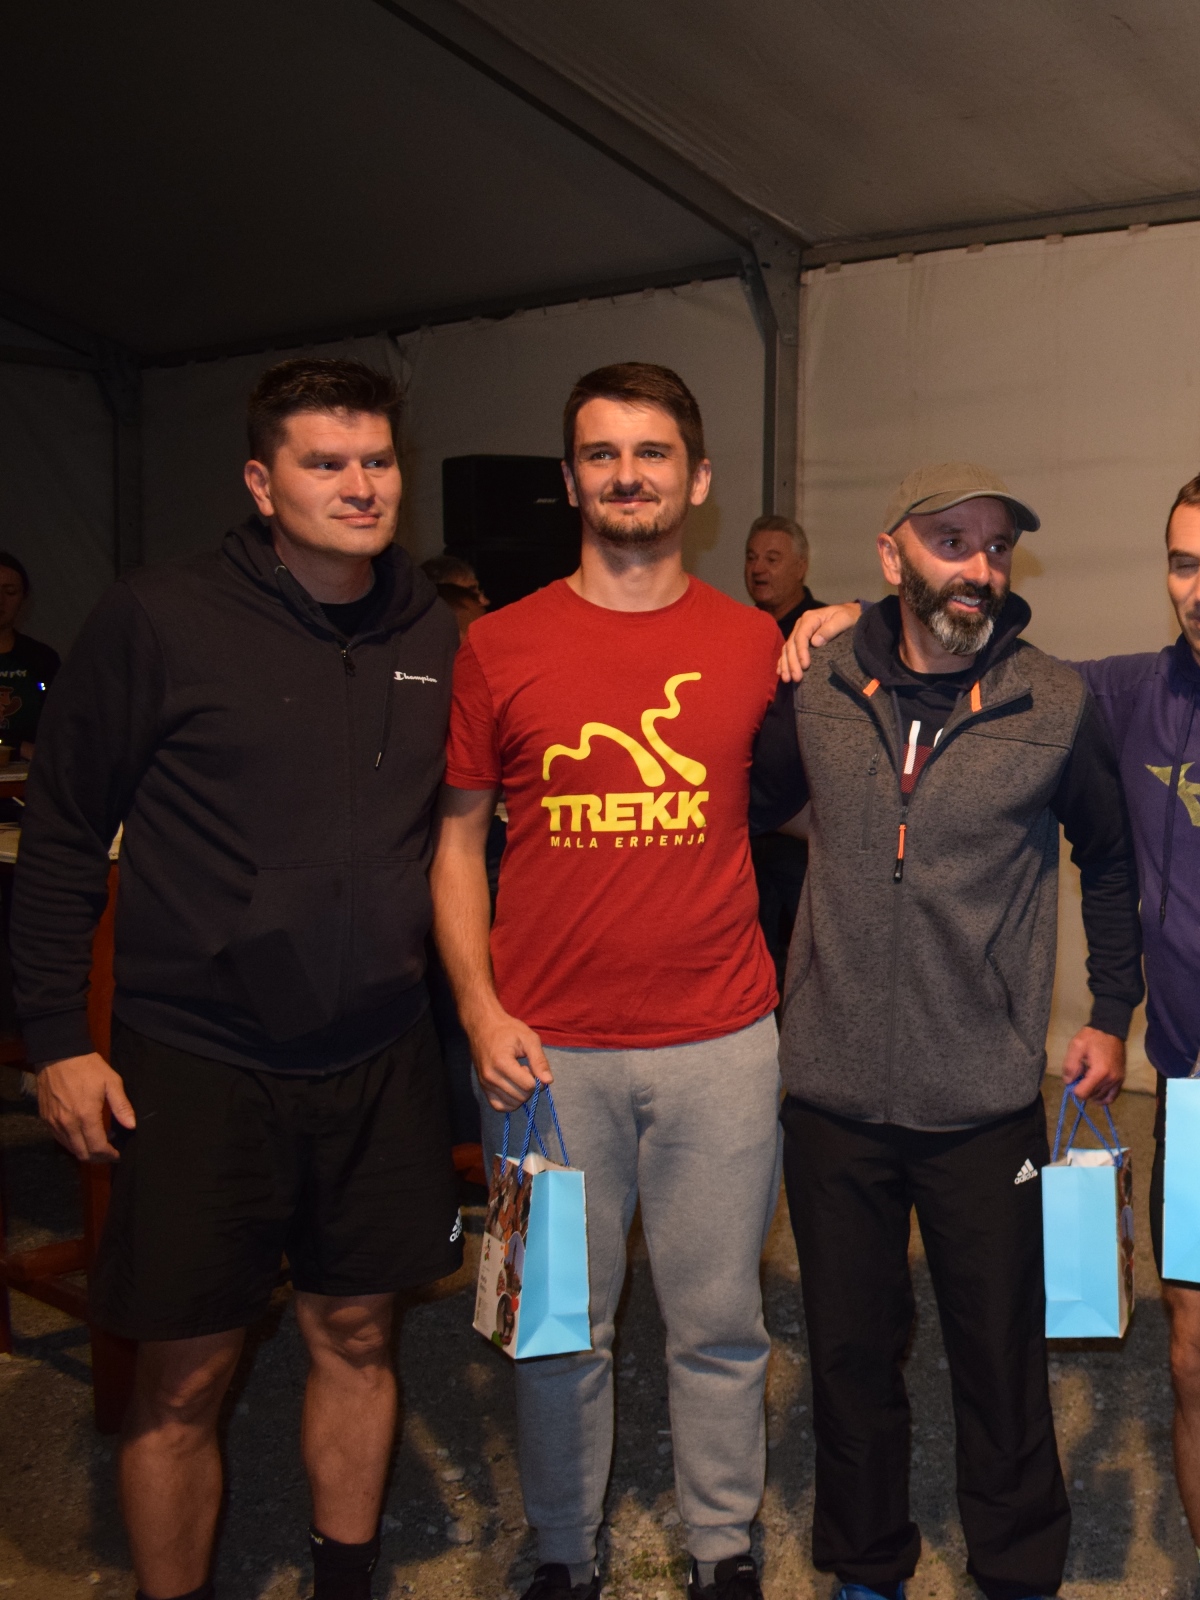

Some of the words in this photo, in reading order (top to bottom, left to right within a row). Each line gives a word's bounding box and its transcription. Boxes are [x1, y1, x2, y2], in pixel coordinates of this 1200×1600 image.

[393, 671, 438, 684] Champion
[540, 790, 710, 832] TREKK
[550, 835, 598, 848] MALA
[615, 832, 706, 848] ERPENJA
[1014, 1168, 1039, 1185] adidas
